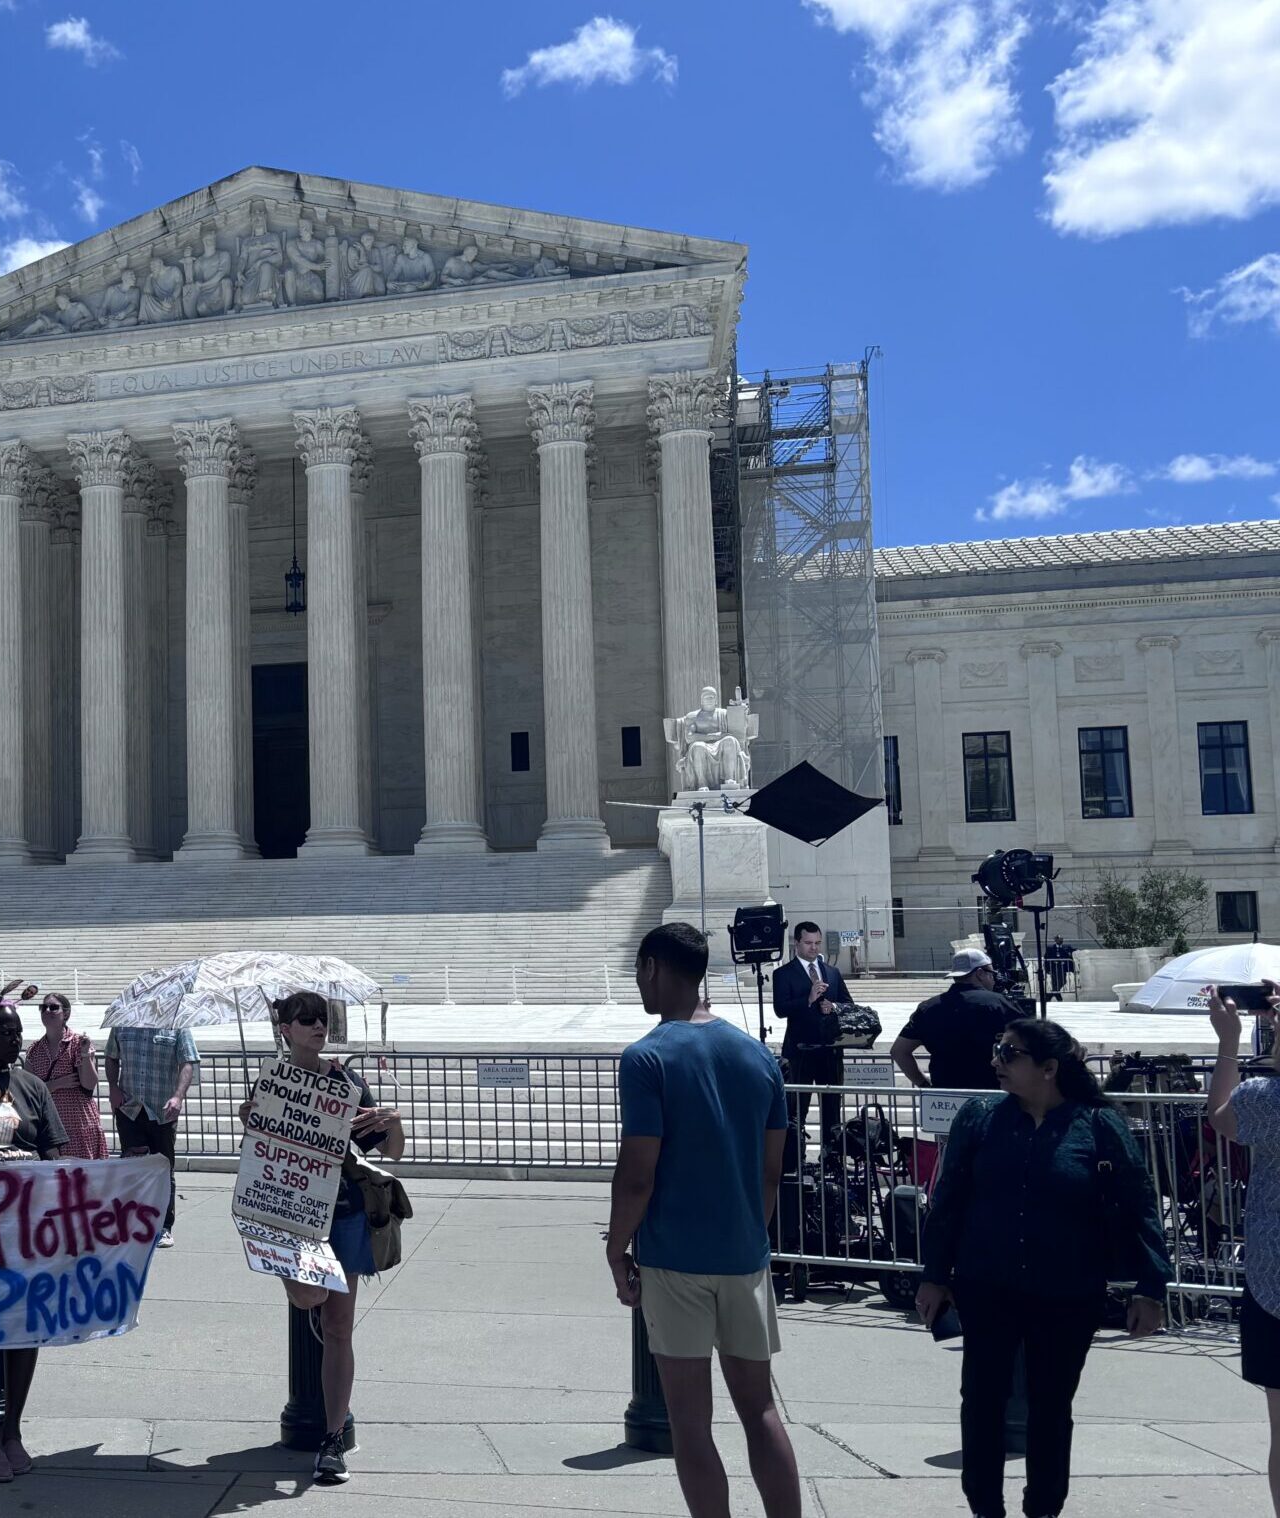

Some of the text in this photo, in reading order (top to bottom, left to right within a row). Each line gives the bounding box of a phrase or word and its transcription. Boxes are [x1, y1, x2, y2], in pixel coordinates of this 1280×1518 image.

[109, 345, 424, 395] EQUAL JUSTICE UNDER LAW
[271, 1062, 351, 1099] JUSTICES
[259, 1079, 352, 1118] should NOT
[930, 1101, 957, 1110] AREA
[282, 1102, 321, 1129] have
[248, 1112, 345, 1156] SUGARDADDIES
[254, 1140, 333, 1178] SUPPORT
[262, 1164, 309, 1191] S. 359
[237, 1195, 326, 1230] TRANSPARENCY ACT
[253, 1180, 330, 1212] SUPREME COURT
[281, 1198, 321, 1219] RECUSAL
[246, 1240, 293, 1265] One-Hour
